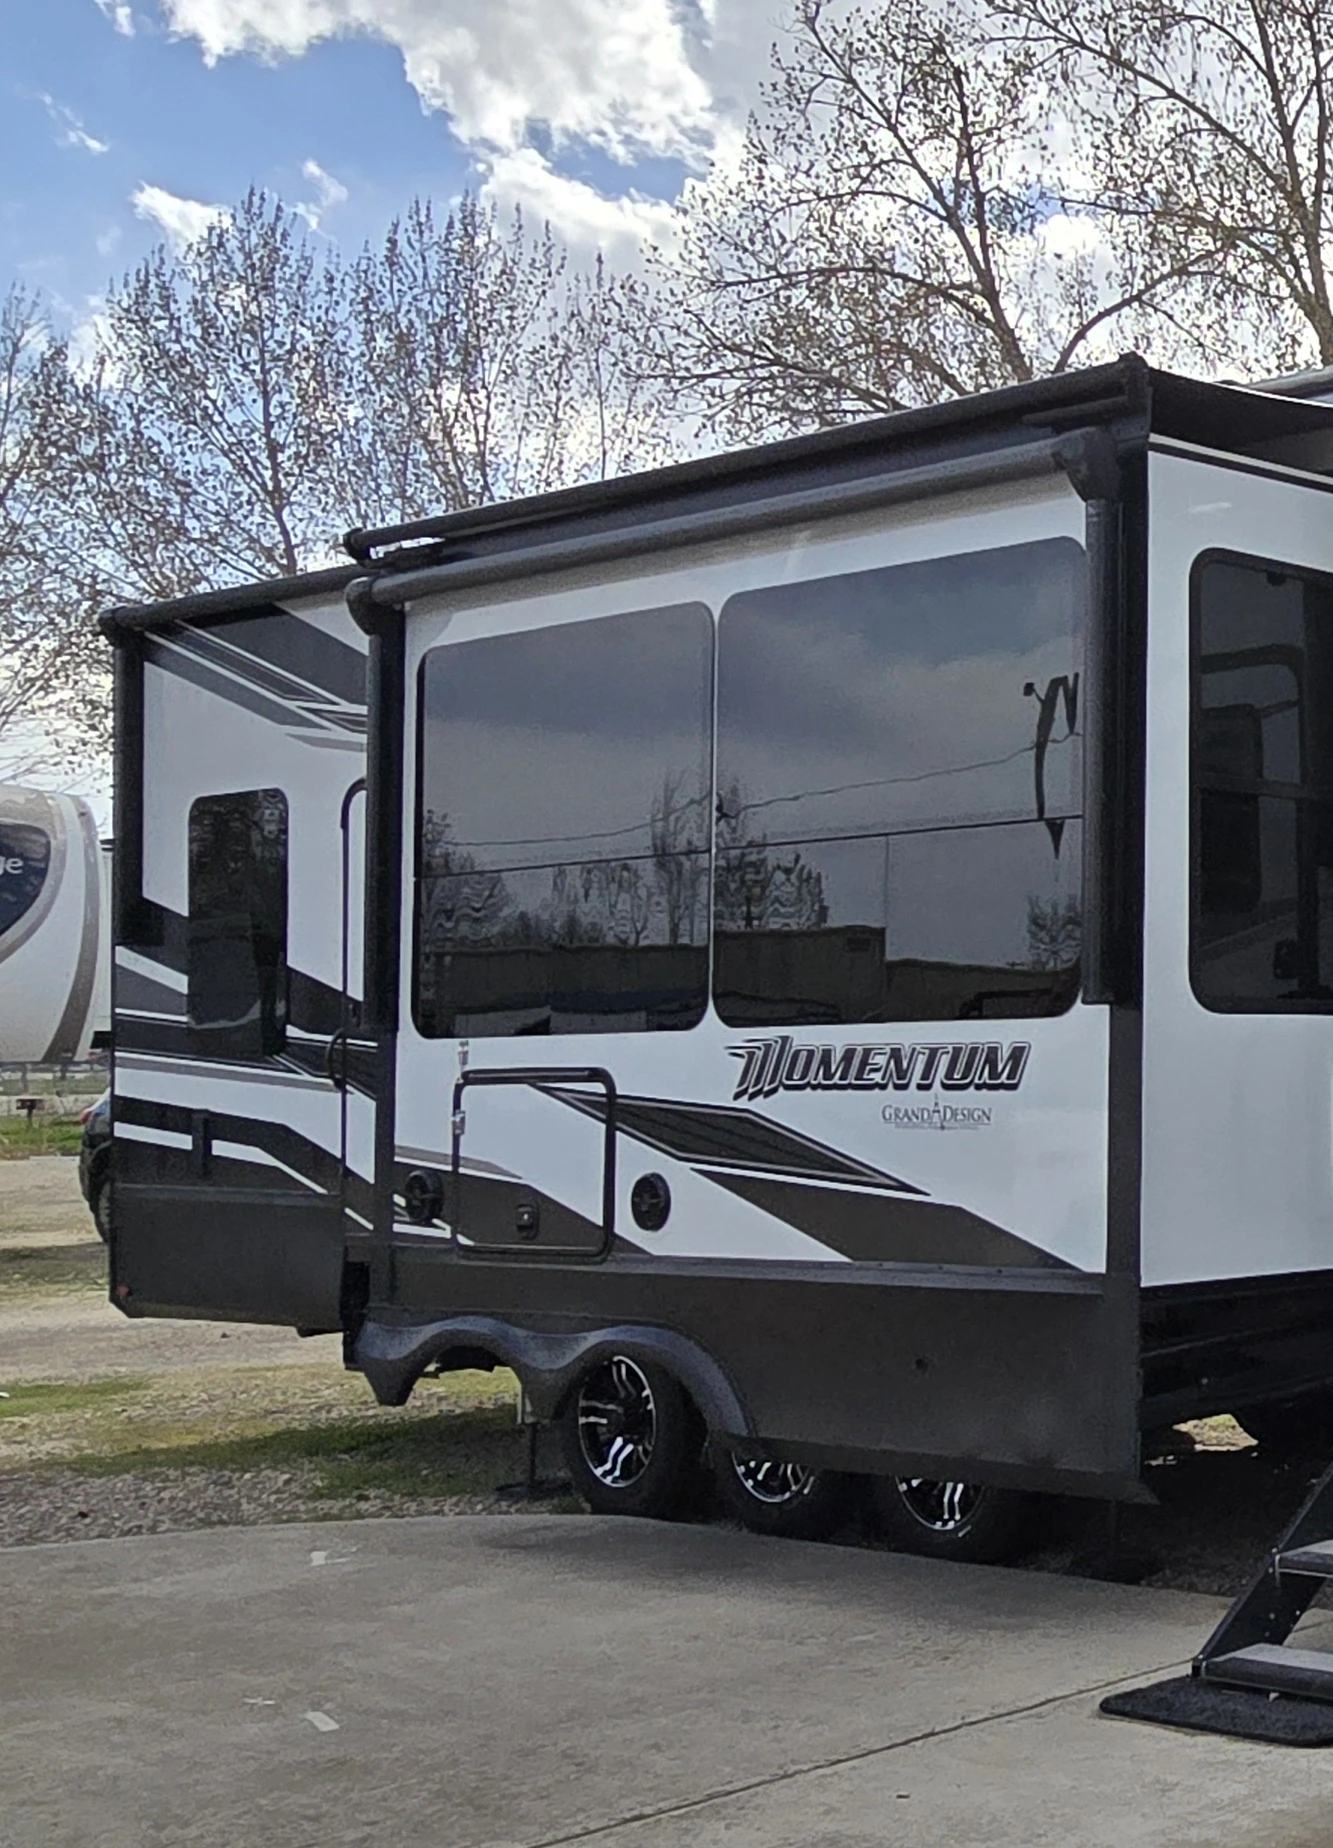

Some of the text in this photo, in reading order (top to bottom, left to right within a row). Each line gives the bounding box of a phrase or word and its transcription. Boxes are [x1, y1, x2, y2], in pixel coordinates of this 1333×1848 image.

[726, 1035, 1032, 1101] MOMENTUM
[881, 1104, 992, 1123] GRAND DESIGN
